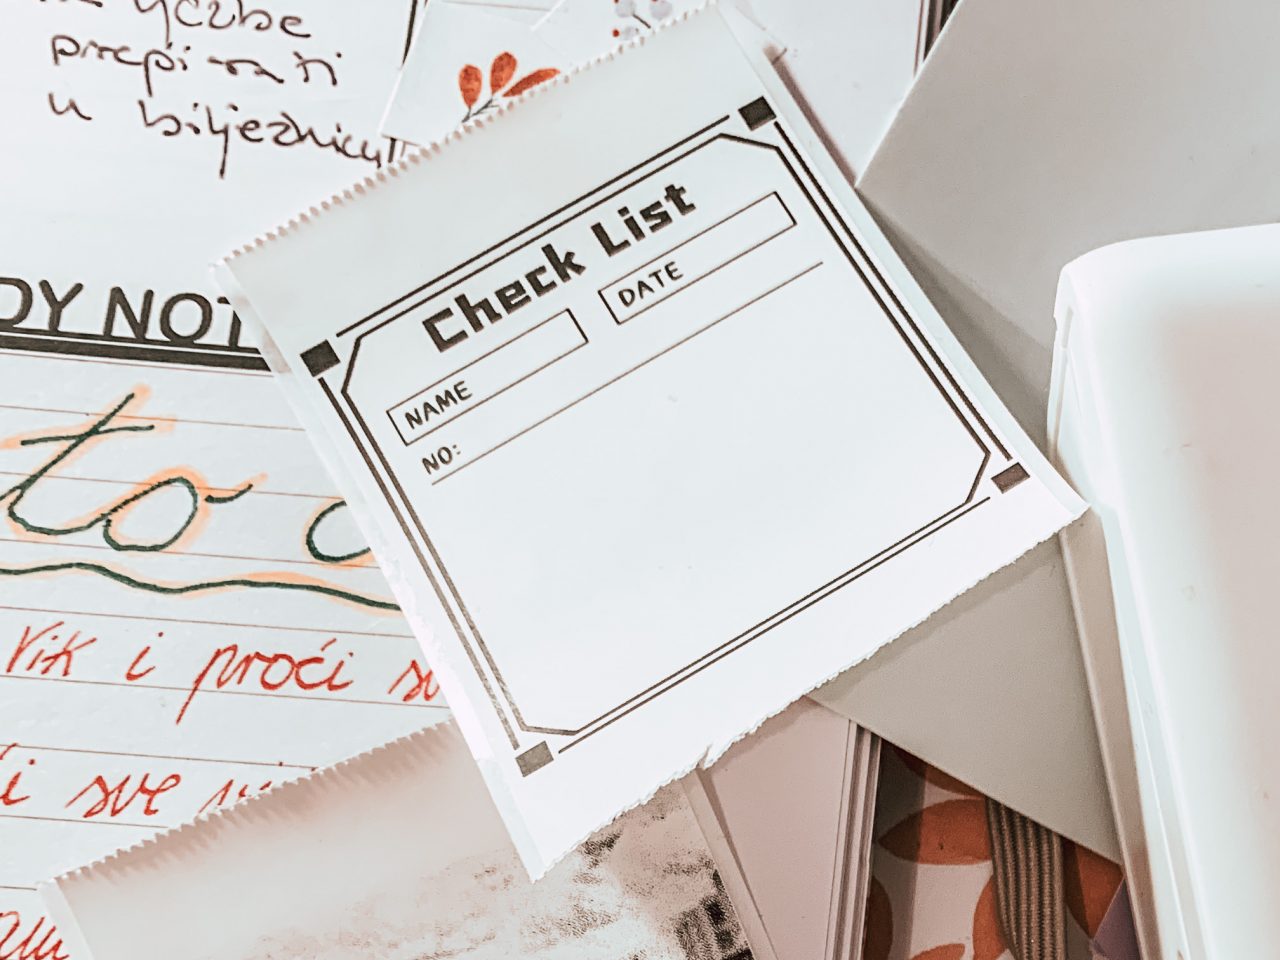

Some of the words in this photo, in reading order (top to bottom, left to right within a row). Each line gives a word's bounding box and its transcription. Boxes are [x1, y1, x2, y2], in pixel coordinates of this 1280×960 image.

[422, 243, 586, 352] Check
[590, 183, 696, 257] List
[618, 261, 684, 307] DATE
[404, 380, 473, 429] NAME
[421, 442, 462, 475] NO:
